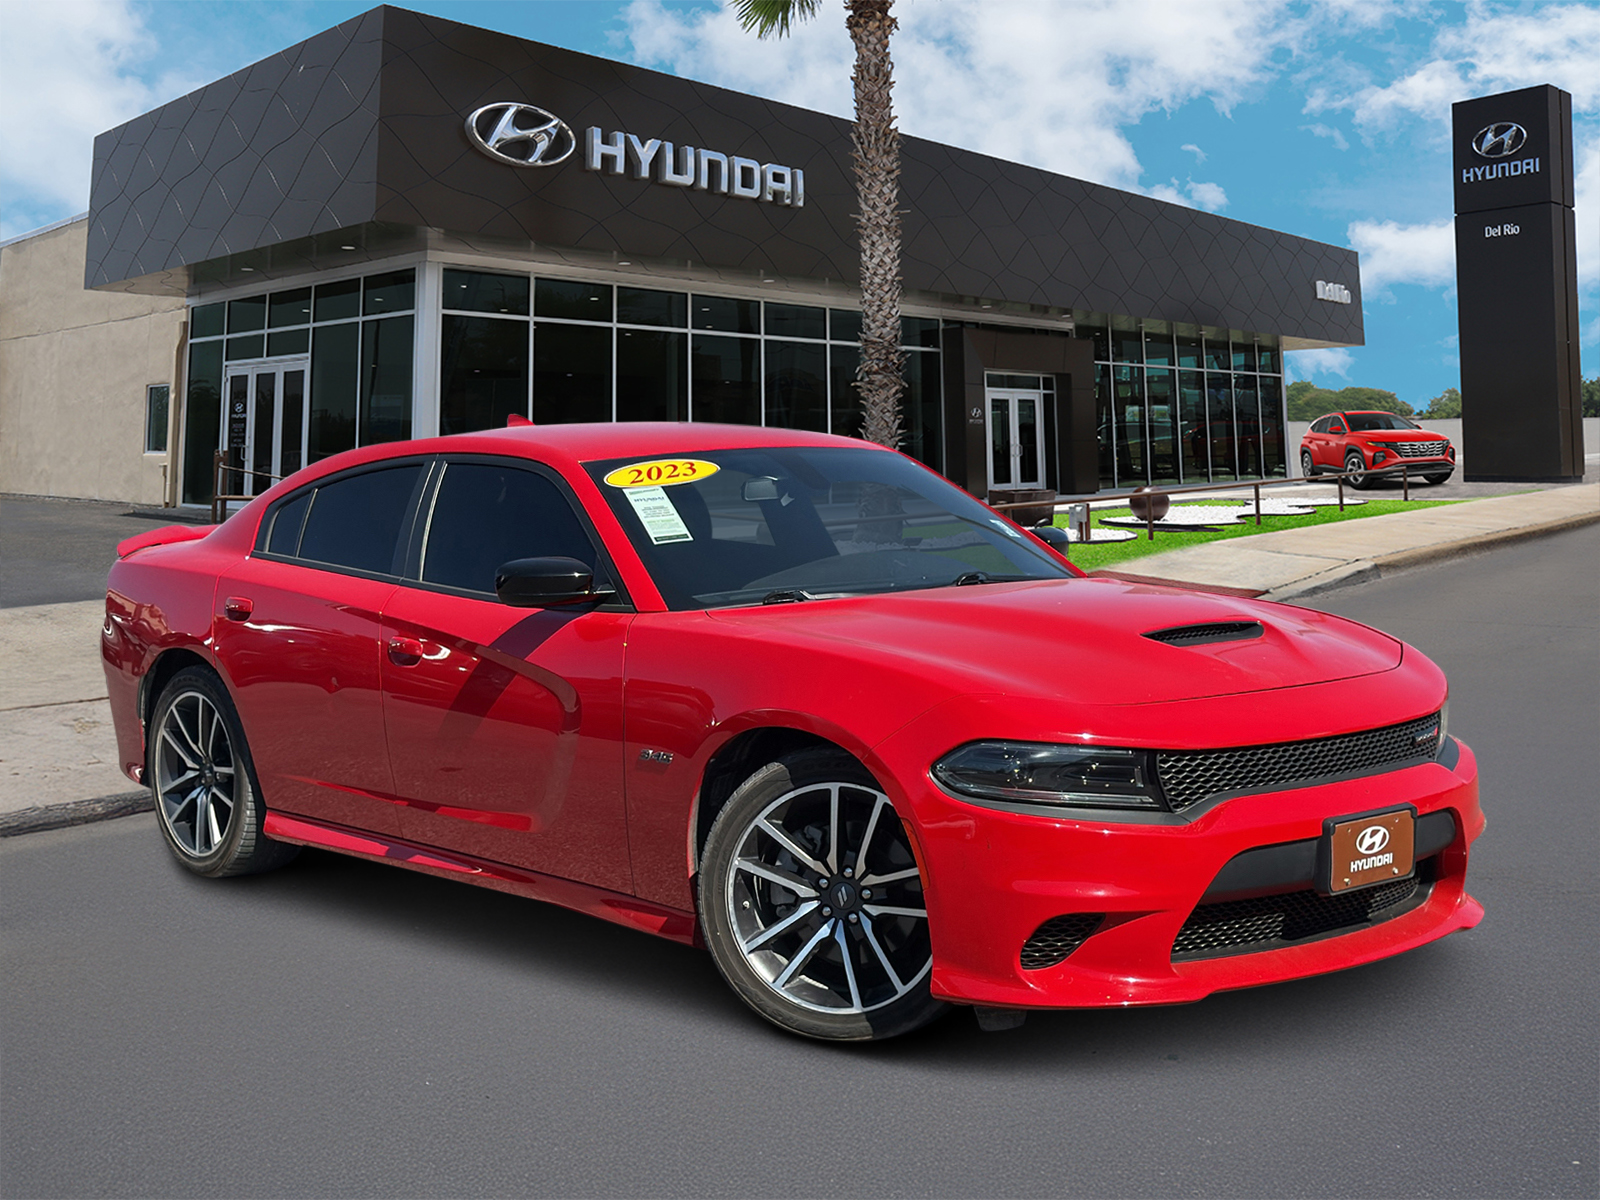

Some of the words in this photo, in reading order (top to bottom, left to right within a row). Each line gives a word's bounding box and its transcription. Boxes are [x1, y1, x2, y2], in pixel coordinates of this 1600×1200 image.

[585, 125, 804, 208] HYUNDAI
[1462, 157, 1540, 183] HYUNDAI
[1484, 225, 1501, 238] Del
[1503, 223, 1520, 235] Rio
[628, 461, 697, 485] 2023
[1350, 852, 1393, 873] HYUNDAI
